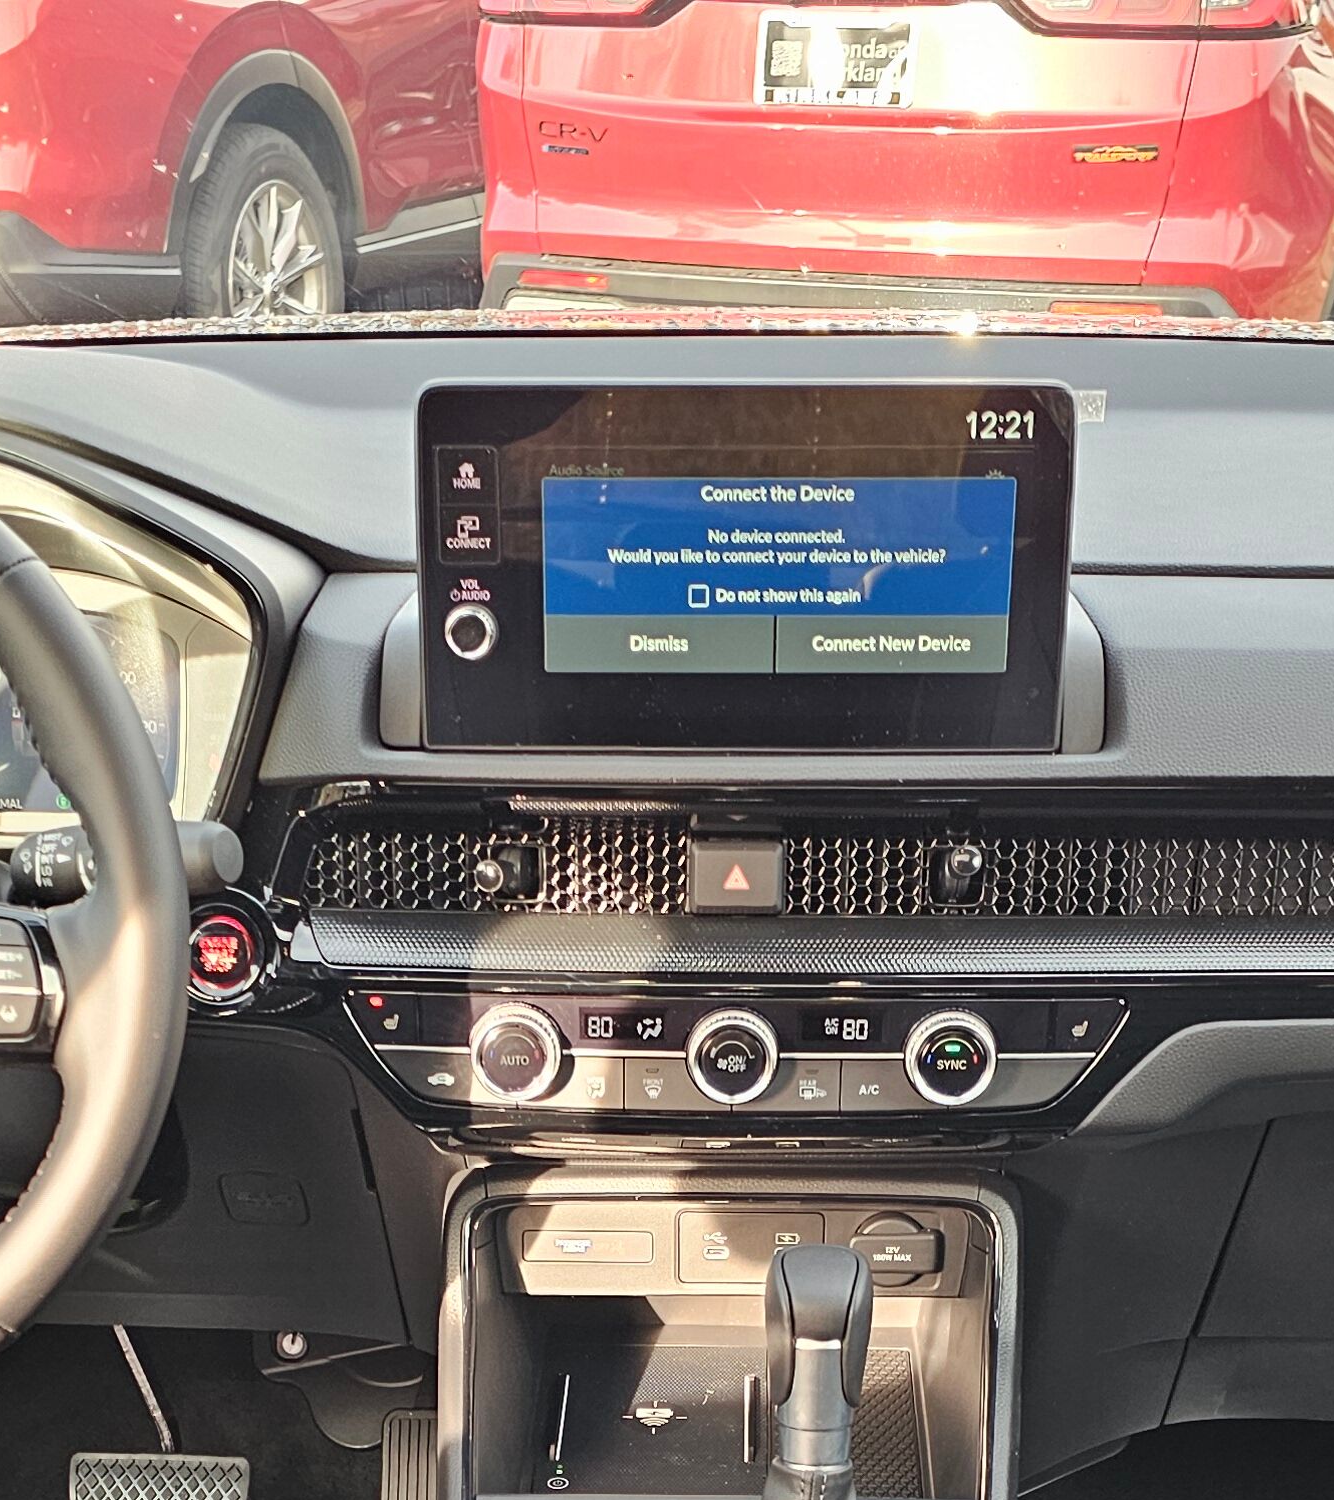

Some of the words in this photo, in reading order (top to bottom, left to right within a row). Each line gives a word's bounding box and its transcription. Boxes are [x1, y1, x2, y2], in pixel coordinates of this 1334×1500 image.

[539, 120, 609, 142] CR-V
[966, 410, 1035, 441] 12:21
[452, 477, 481, 490] HOME
[701, 484, 767, 502] Connect
[770, 484, 797, 502] the
[800, 485, 855, 502] Device
[446, 537, 491, 549] CONNECT
[708, 529, 729, 544] No
[731, 528, 772, 544] device
[774, 529, 846, 544] connected.
[608, 548, 652, 563] Would
[654, 551, 679, 565] you
[681, 548, 704, 563] like
[706, 549, 720, 563] to
[722, 549, 775, 563] connect
[776, 551, 807, 565] your
[809, 548, 852, 563] device
[853, 549, 868, 563] to
[870, 549, 893, 563] the
[895, 549, 947, 563] vehicle?
[460, 579, 480, 590] VOL
[462, 590, 490, 601] AUDIO
[716, 588, 735, 602] Do
[738, 589, 760, 602] not
[762, 588, 798, 602] show
[800, 588, 824, 602] this
[826, 589, 861, 604] again
[629, 634, 689, 652] Dismiss
[812, 635, 877, 652] Connect
[879, 635, 916, 652] New
[918, 634, 972, 653] Device
[587, 1016, 613, 1038] 80
[824, 1018, 839, 1027] A/C
[842, 1018, 869, 1040] 80
[825, 1026, 838, 1035] ON
[499, 1055, 530, 1066] AUTO
[936, 1060, 967, 1071] SYNC
[728, 1064, 746, 1073] OFF
[859, 1084, 880, 1095] A/C
